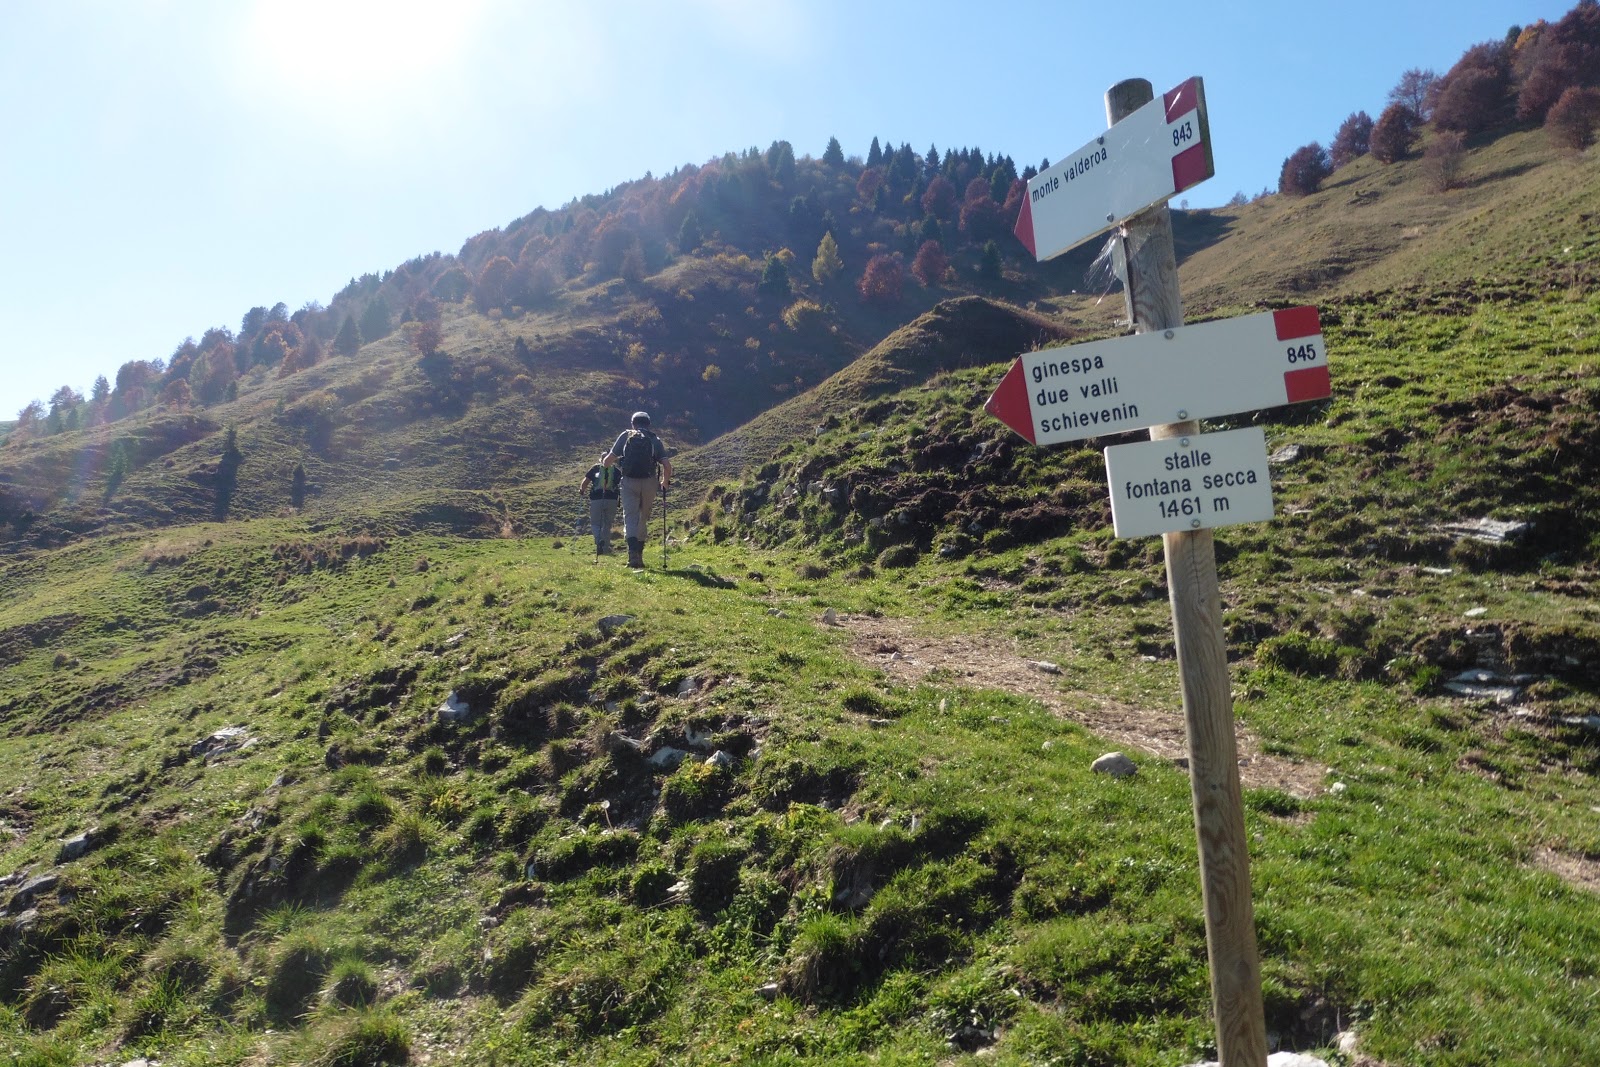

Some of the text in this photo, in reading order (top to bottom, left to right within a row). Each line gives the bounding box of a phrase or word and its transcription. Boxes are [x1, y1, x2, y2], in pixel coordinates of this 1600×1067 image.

[1173, 121, 1193, 147] 843
[1032, 147, 1107, 202] monte valderoa
[1287, 344, 1316, 363] 845
[1032, 354, 1104, 382] ginespa
[1037, 377, 1118, 406] due valli
[1041, 403, 1138, 432] schievenin
[1164, 450, 1211, 470] stalle
[1126, 469, 1257, 499] fontana secca
[1213, 496, 1230, 512] m
